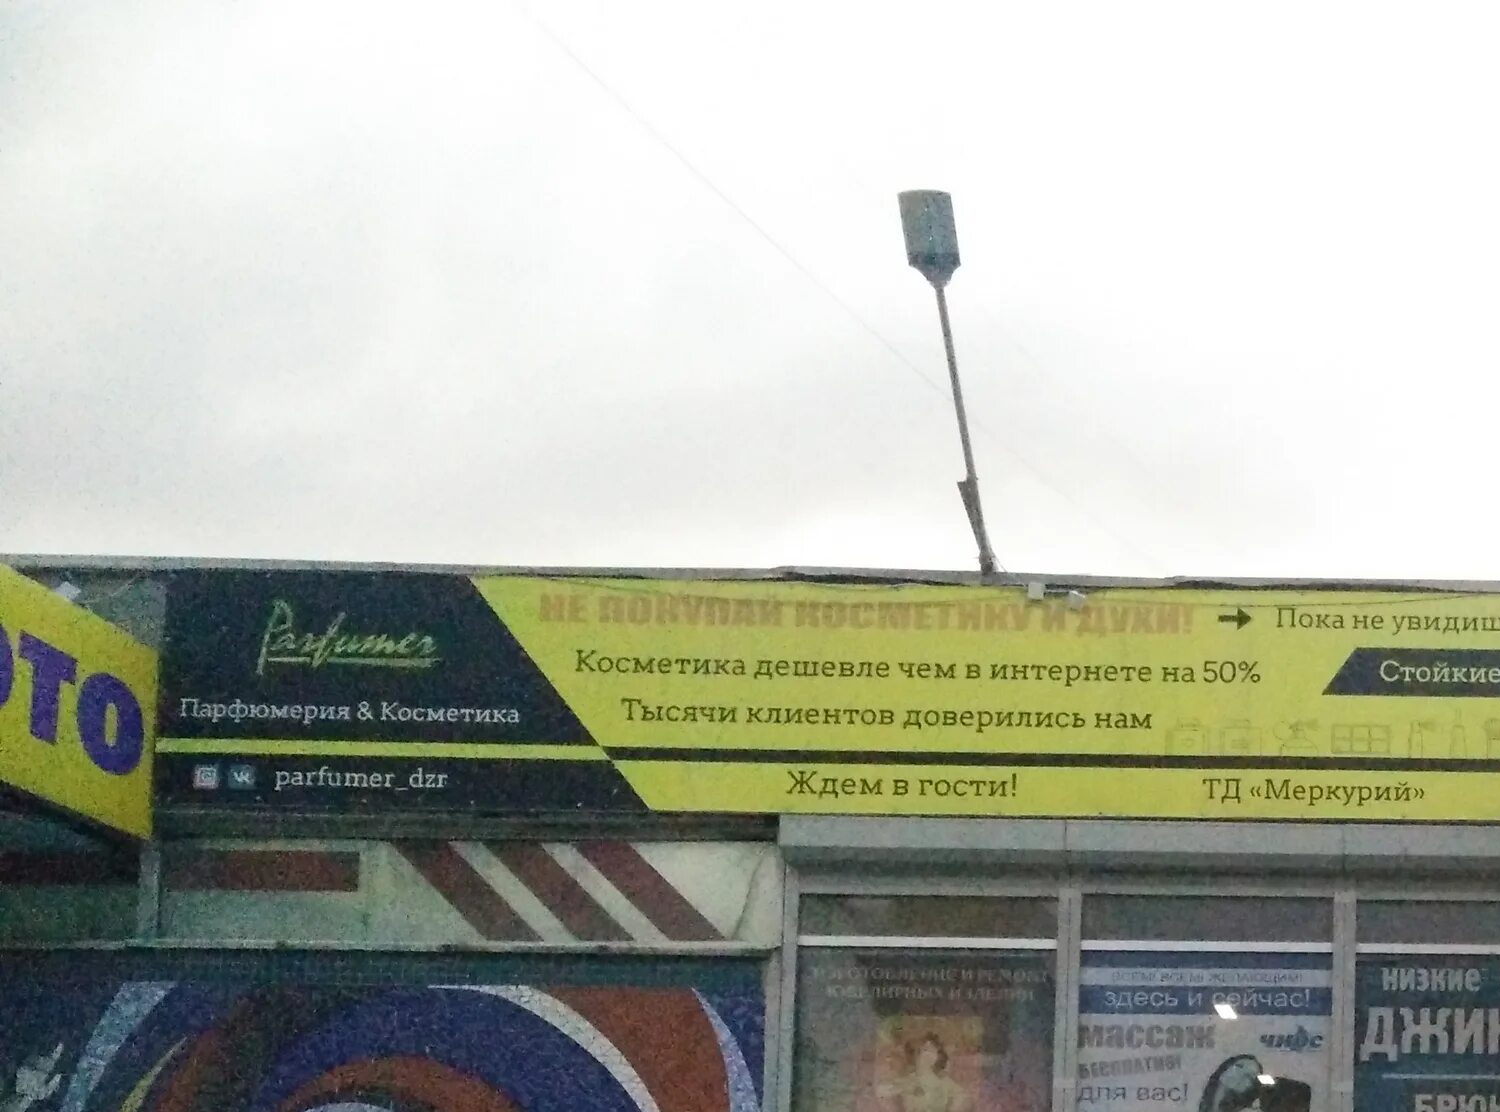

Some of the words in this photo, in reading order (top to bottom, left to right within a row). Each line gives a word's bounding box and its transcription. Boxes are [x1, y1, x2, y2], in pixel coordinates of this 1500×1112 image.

[540, 595, 591, 624] НЕ
[795, 599, 1034, 632] КОСМЕТИКУ
[1075, 602, 1196, 638] ДУХИ!
[1275, 607, 1347, 632] Пока
[1352, 612, 1385, 632] не
[574, 648, 748, 680] Косметика
[753, 656, 891, 682] дешевле
[898, 659, 958, 681] чем
[965, 660, 981, 680] в
[989, 661, 1153, 686] интернете
[1161, 664, 1196, 684] на
[1202, 660, 1263, 685] 50%
[0, 622, 145, 776] ТО
[179, 696, 350, 726] Парфюмерия
[356, 701, 375, 723] &
[379, 700, 521, 726] Косметика
[620, 697, 738, 726] Тысячи
[745, 704, 895, 727] клиентов
[902, 706, 1087, 733] доверились
[1093, 711, 1153, 731] нам
[273, 764, 450, 794] parfumer_dzr
[784, 769, 884, 800] Ждем
[892, 778, 909, 797] в
[917, 771, 1019, 799] гости!
[1202, 778, 1242, 806] ТД
[1249, 779, 1426, 808] «Меркурий»
[1104, 989, 1178, 1009] здесь
[1187, 991, 1202, 1005] и
[1078, 1024, 1216, 1050] массаж
[1077, 1084, 1127, 1103] для
[1136, 1083, 1189, 1102] вас!
